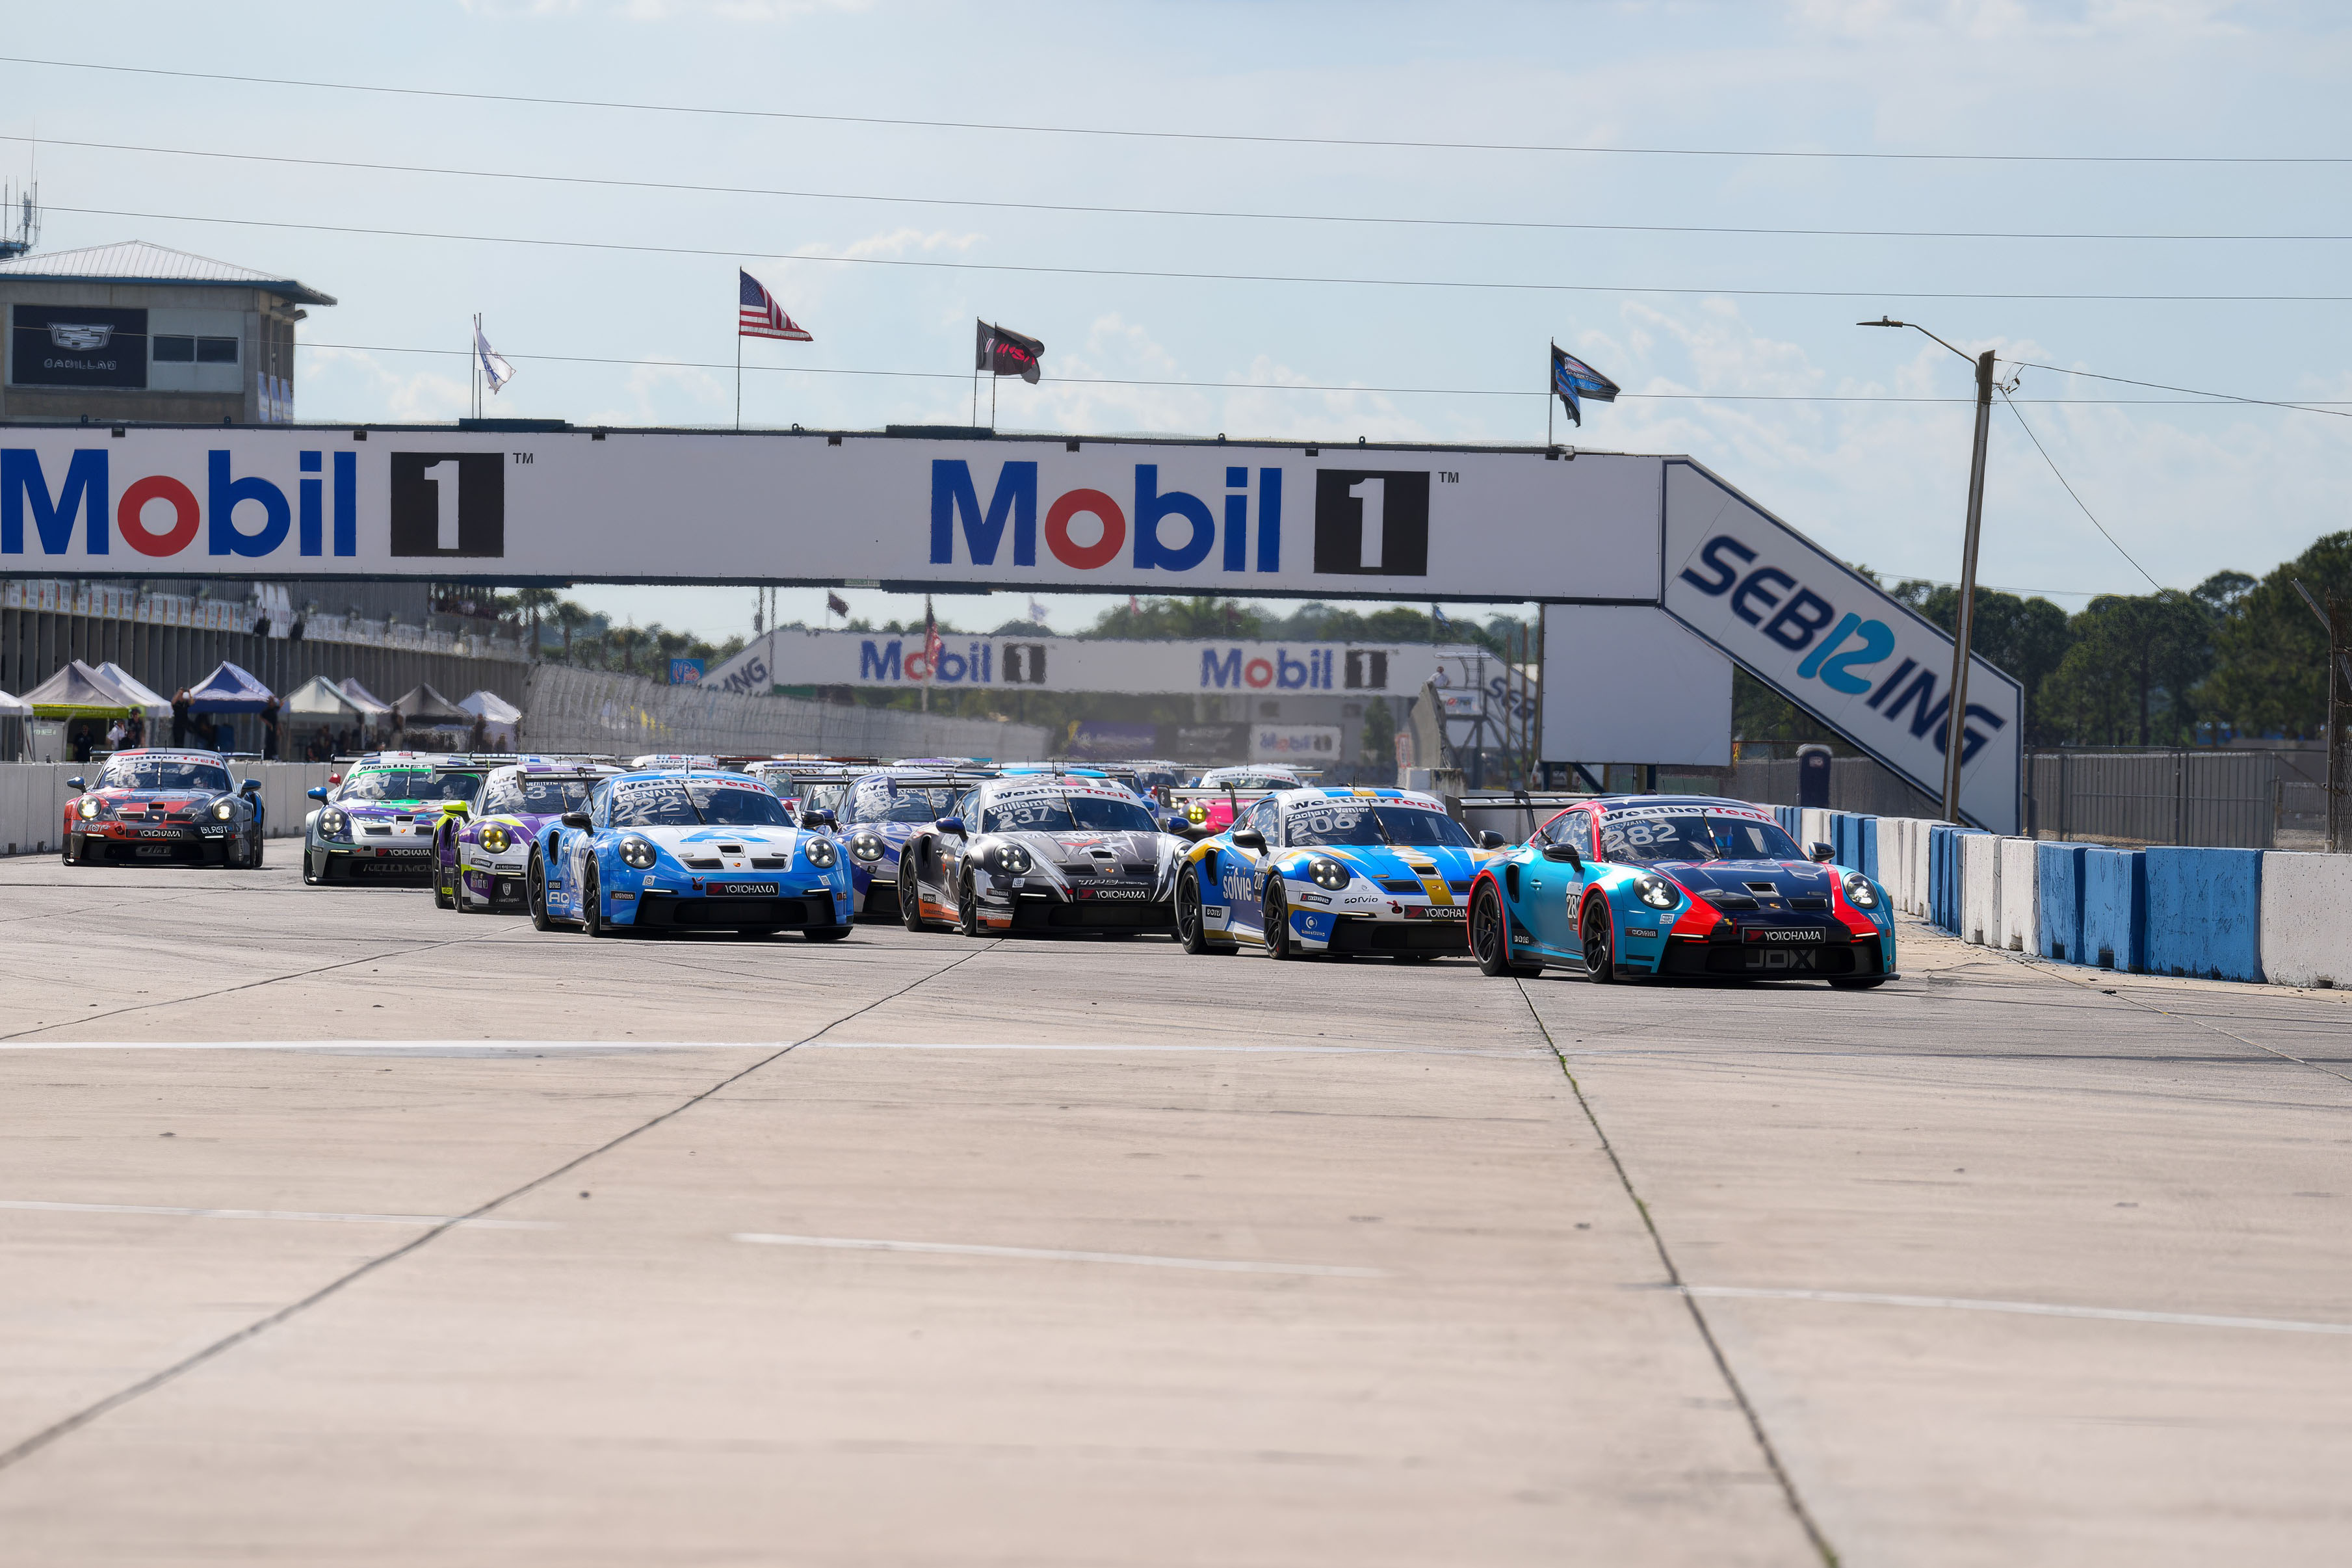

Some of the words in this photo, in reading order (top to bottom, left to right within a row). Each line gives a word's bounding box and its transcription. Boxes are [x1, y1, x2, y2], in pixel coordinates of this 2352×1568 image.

[0, 449, 356, 557] Mobil
[424, 460, 460, 549] 1
[930, 459, 1282, 573] Mobil
[1348, 478, 1385, 568] 1
[1201, 648, 1333, 690] Mobil
[614, 796, 681, 824] 222
[997, 805, 1049, 829] 237
[1288, 797, 1445, 813] WeatherTech
[1602, 807, 1771, 822] WeatherTech
[1287, 813, 1357, 845] 206
[1602, 823, 1680, 853] 282
[1764, 931, 1821, 941] YOKOHAMA
